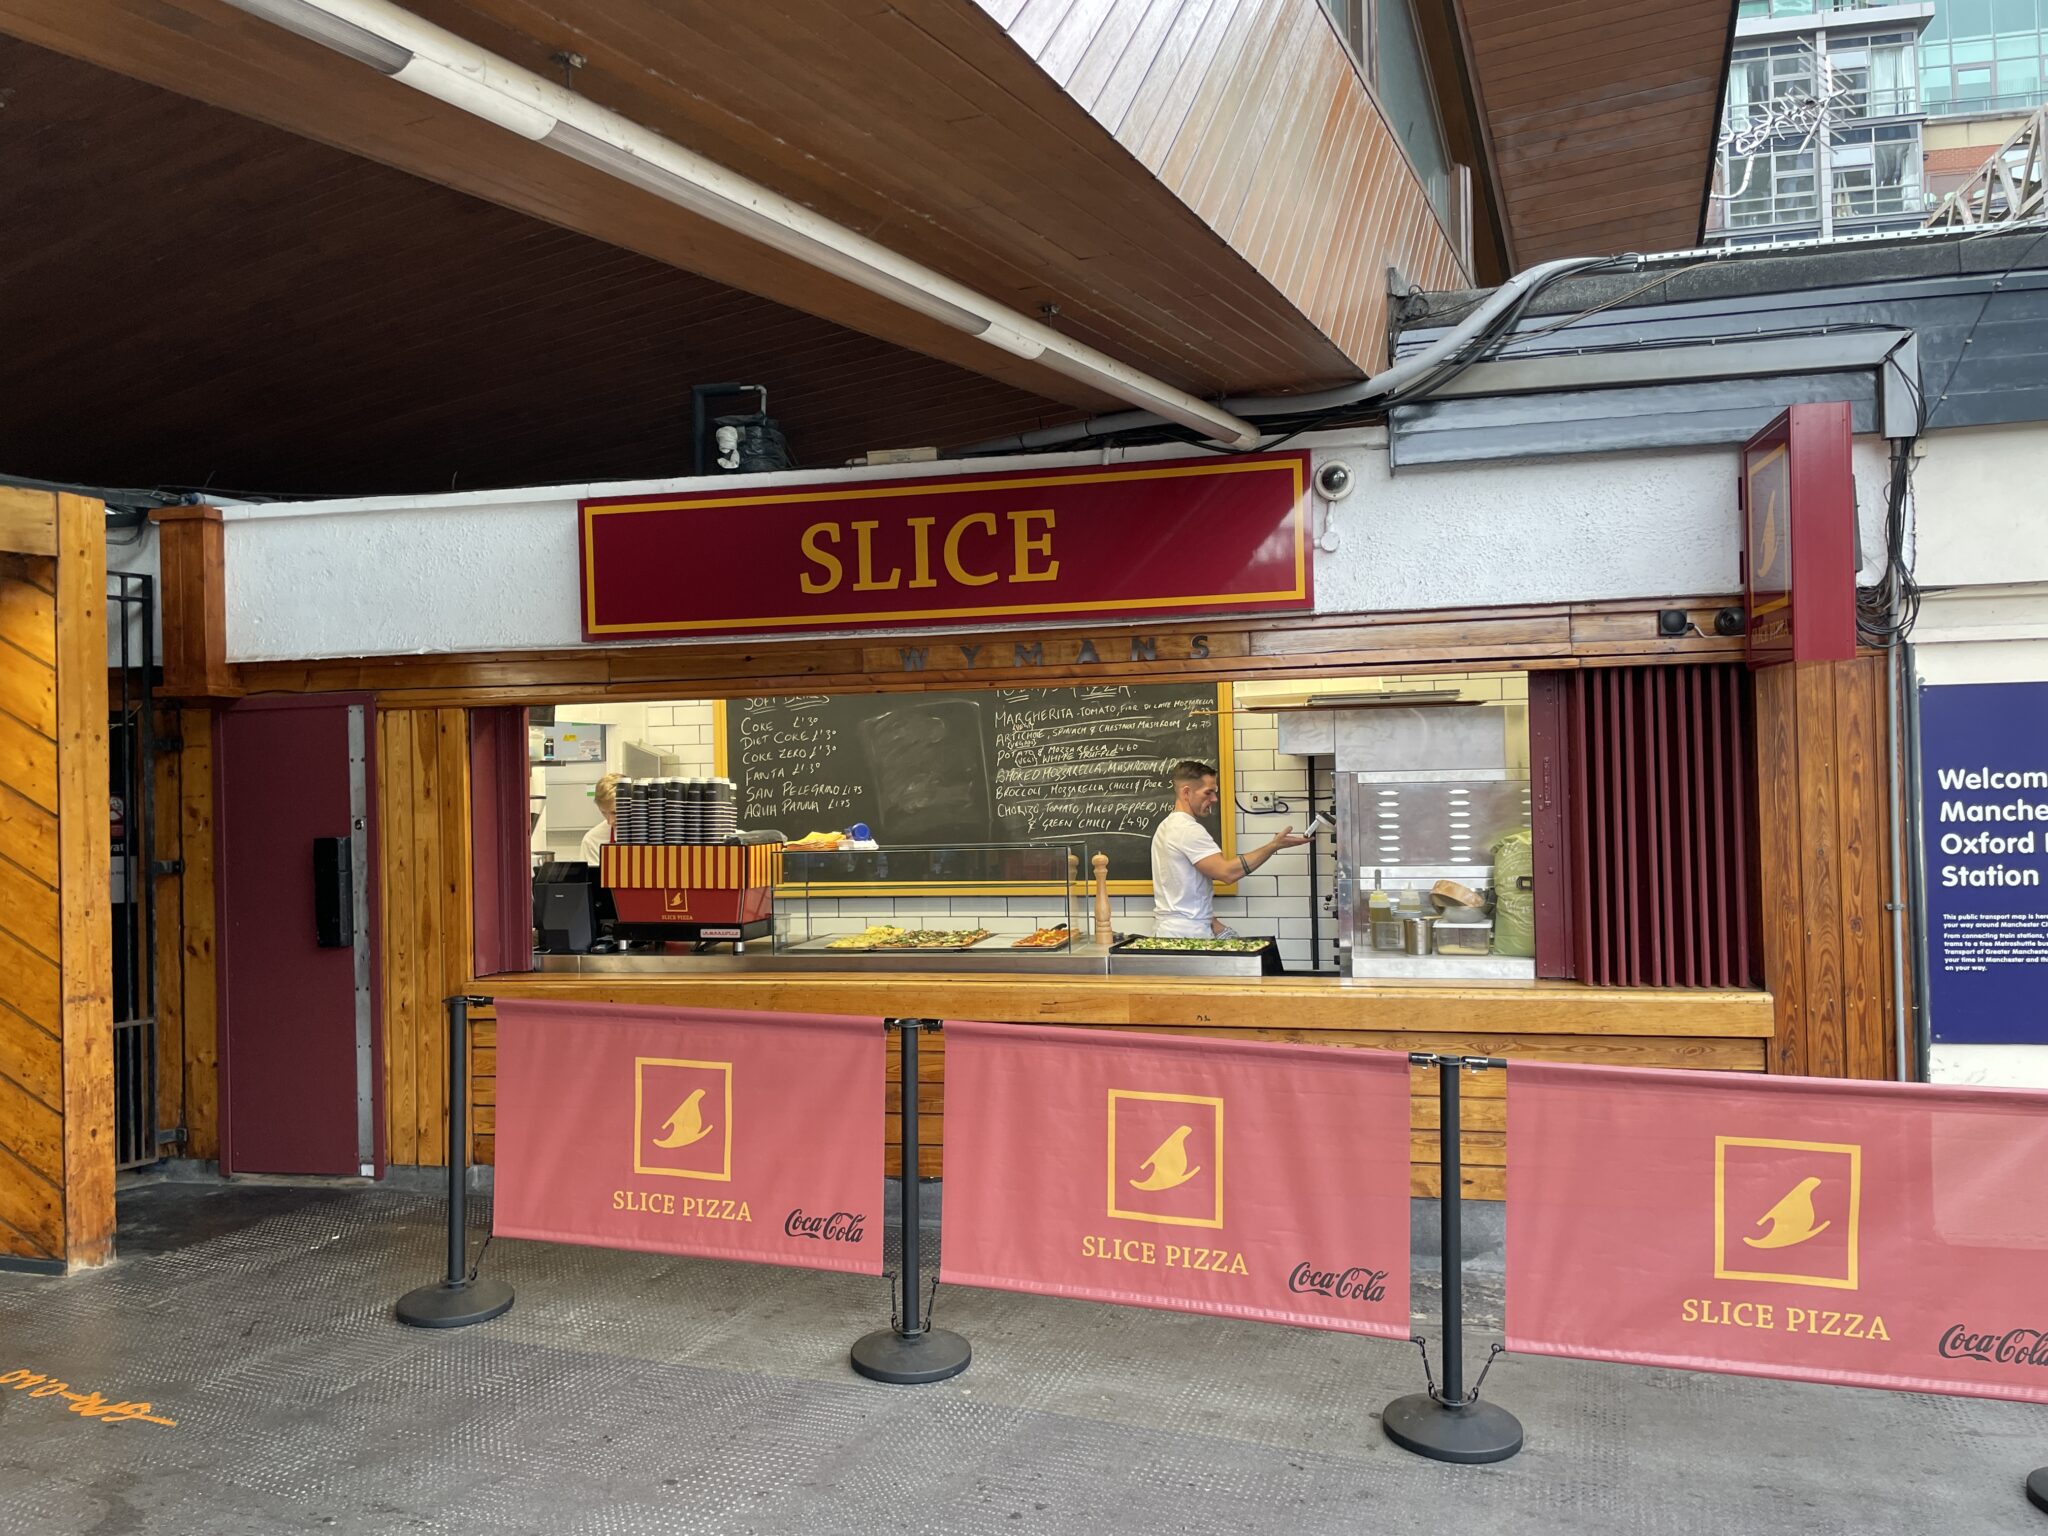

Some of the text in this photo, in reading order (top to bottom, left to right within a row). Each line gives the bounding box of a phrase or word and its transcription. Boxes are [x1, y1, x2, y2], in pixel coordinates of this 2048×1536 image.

[800, 509, 1060, 594] SLICE
[900, 635, 1210, 672] WYMANS
[740, 717, 774, 736] COKE
[995, 708, 1074, 728] MARGHERITA
[1137, 720, 1181, 729] MUSHROOM
[740, 734, 769, 751] DIET
[773, 731, 810, 744] COKE
[1048, 744, 1108, 756] MOZZARELLA
[742, 752, 774, 765] COKE
[779, 748, 807, 759] ZERO
[1107, 760, 1158, 774] MUSHROOM
[745, 766, 785, 787] FANTA
[1938, 766, 2048, 790] Welcom
[746, 786, 774, 802] SAN
[743, 803, 777, 820] AQUA
[781, 798, 820, 815] PANNA
[1940, 798, 2048, 822] Manche
[1042, 819, 1073, 832] GREEN
[1078, 818, 1112, 831] CHILLI
[1941, 831, 2035, 855] Oxford
[1942, 864, 2039, 887] Station
[613, 1191, 753, 1223] SLICE PIZZA
[784, 1208, 867, 1243] Coca-Cola
[1082, 1235, 1249, 1276] SLICE PIZZA
[1288, 1261, 1389, 1303] Coca-Cola
[1682, 1299, 1891, 1342] SLICE PIZZA
